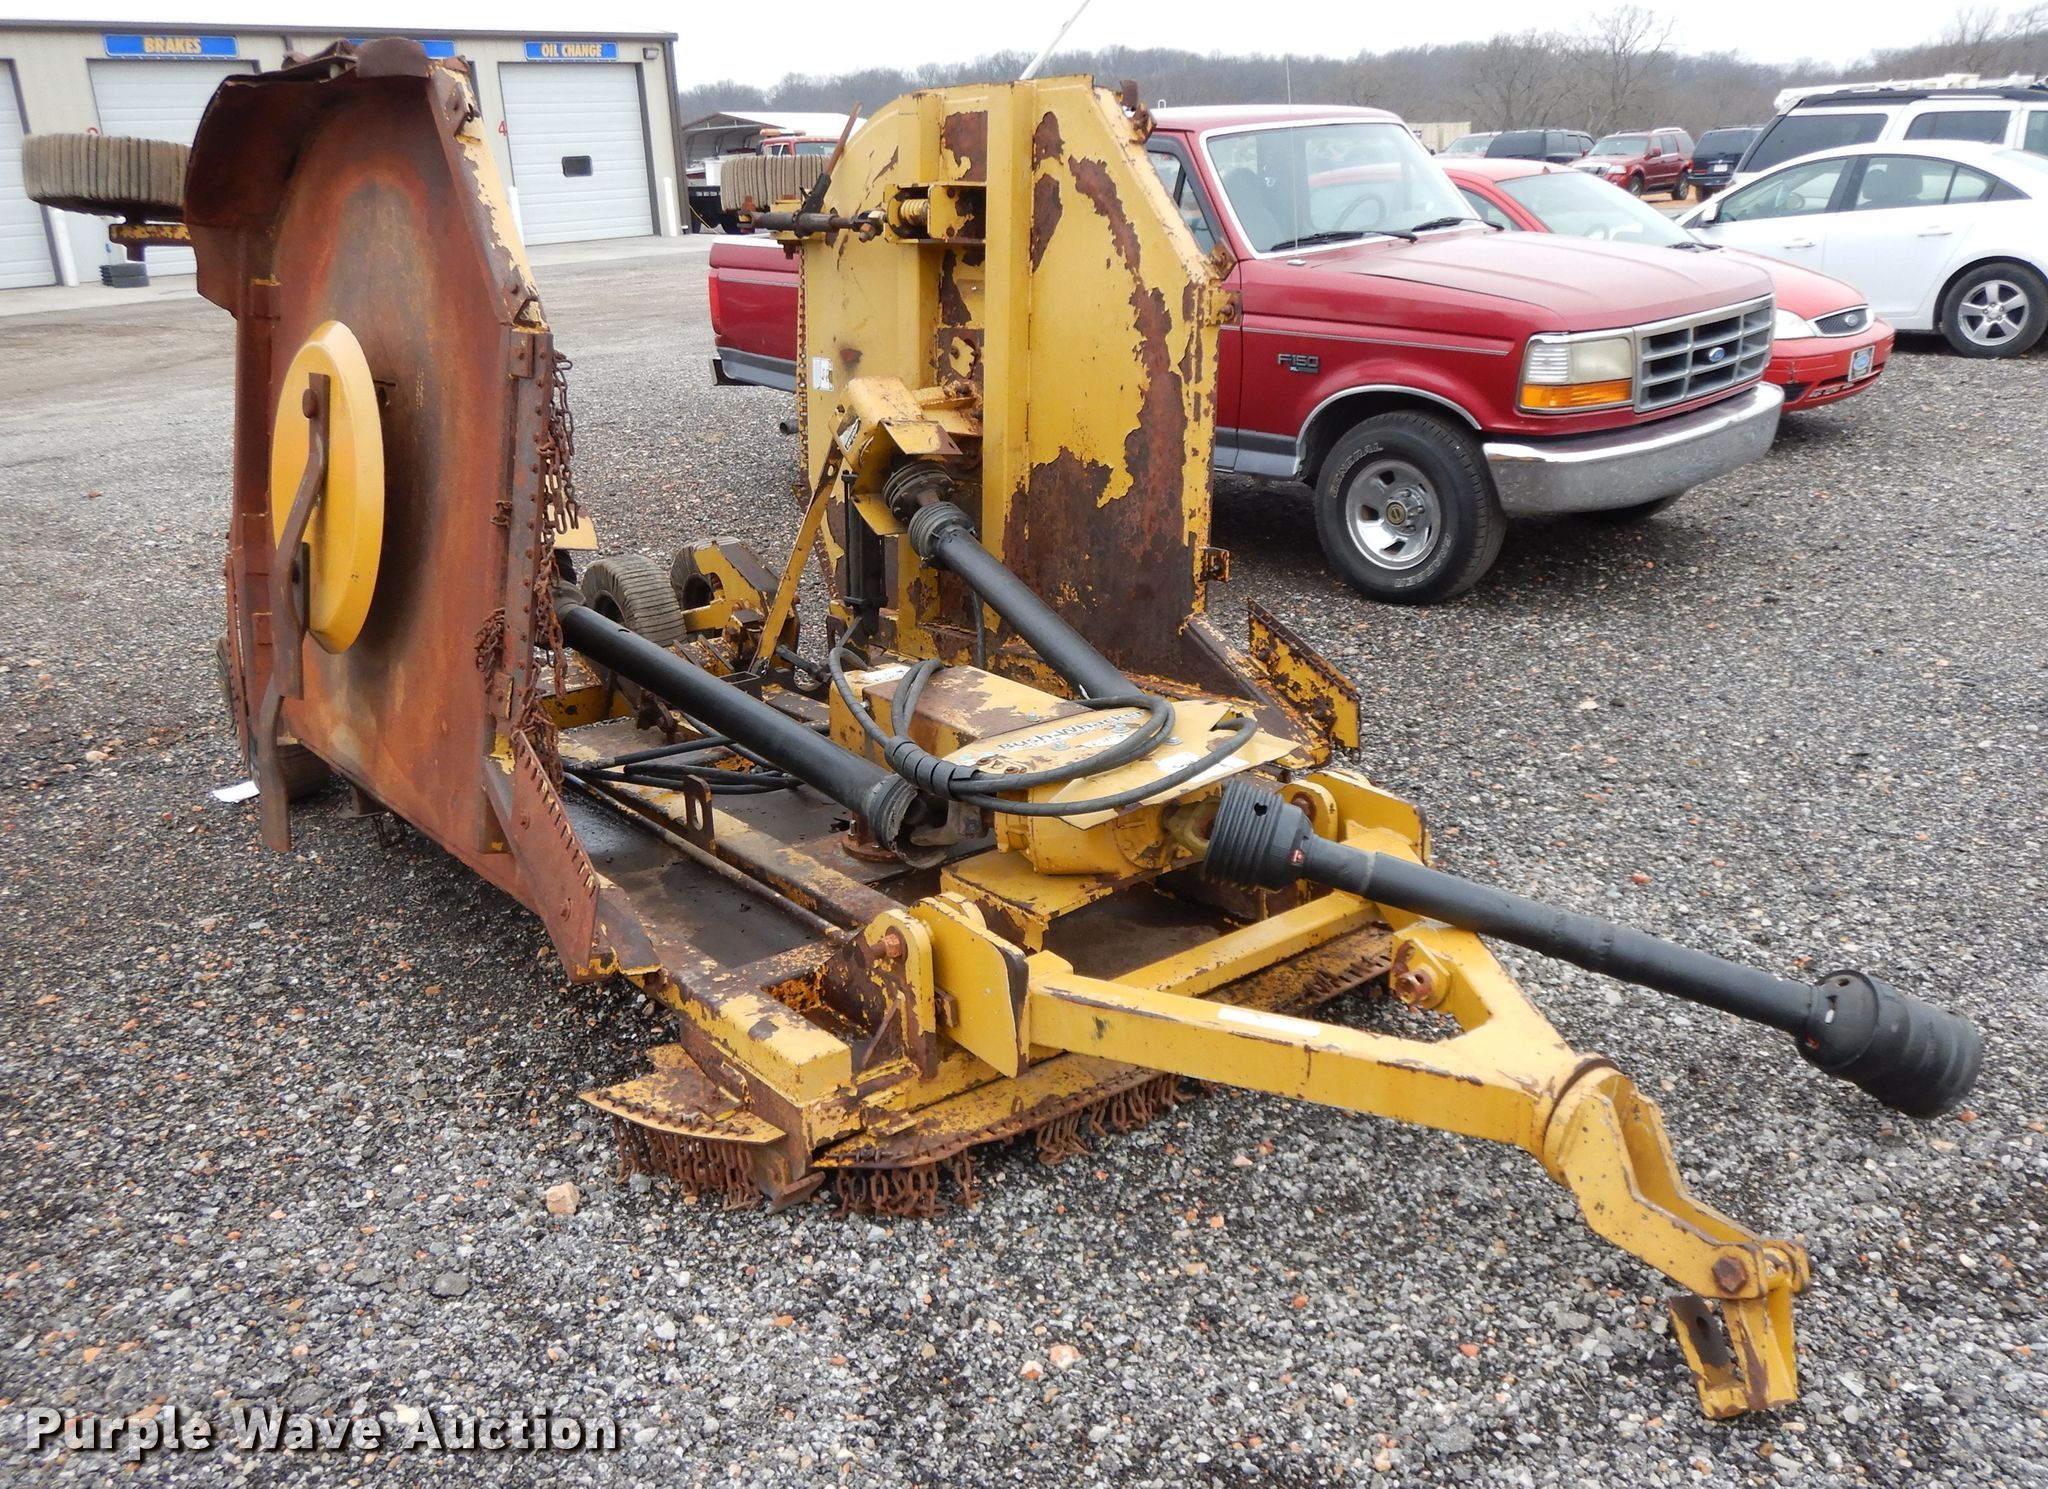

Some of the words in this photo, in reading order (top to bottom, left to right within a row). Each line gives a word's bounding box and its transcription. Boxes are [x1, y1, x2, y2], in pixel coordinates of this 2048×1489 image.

[143, 37, 202, 53] BRAKES
[541, 43, 559, 57] OIL
[561, 43, 602, 58] CHANGE
[498, 120, 507, 136] 4
